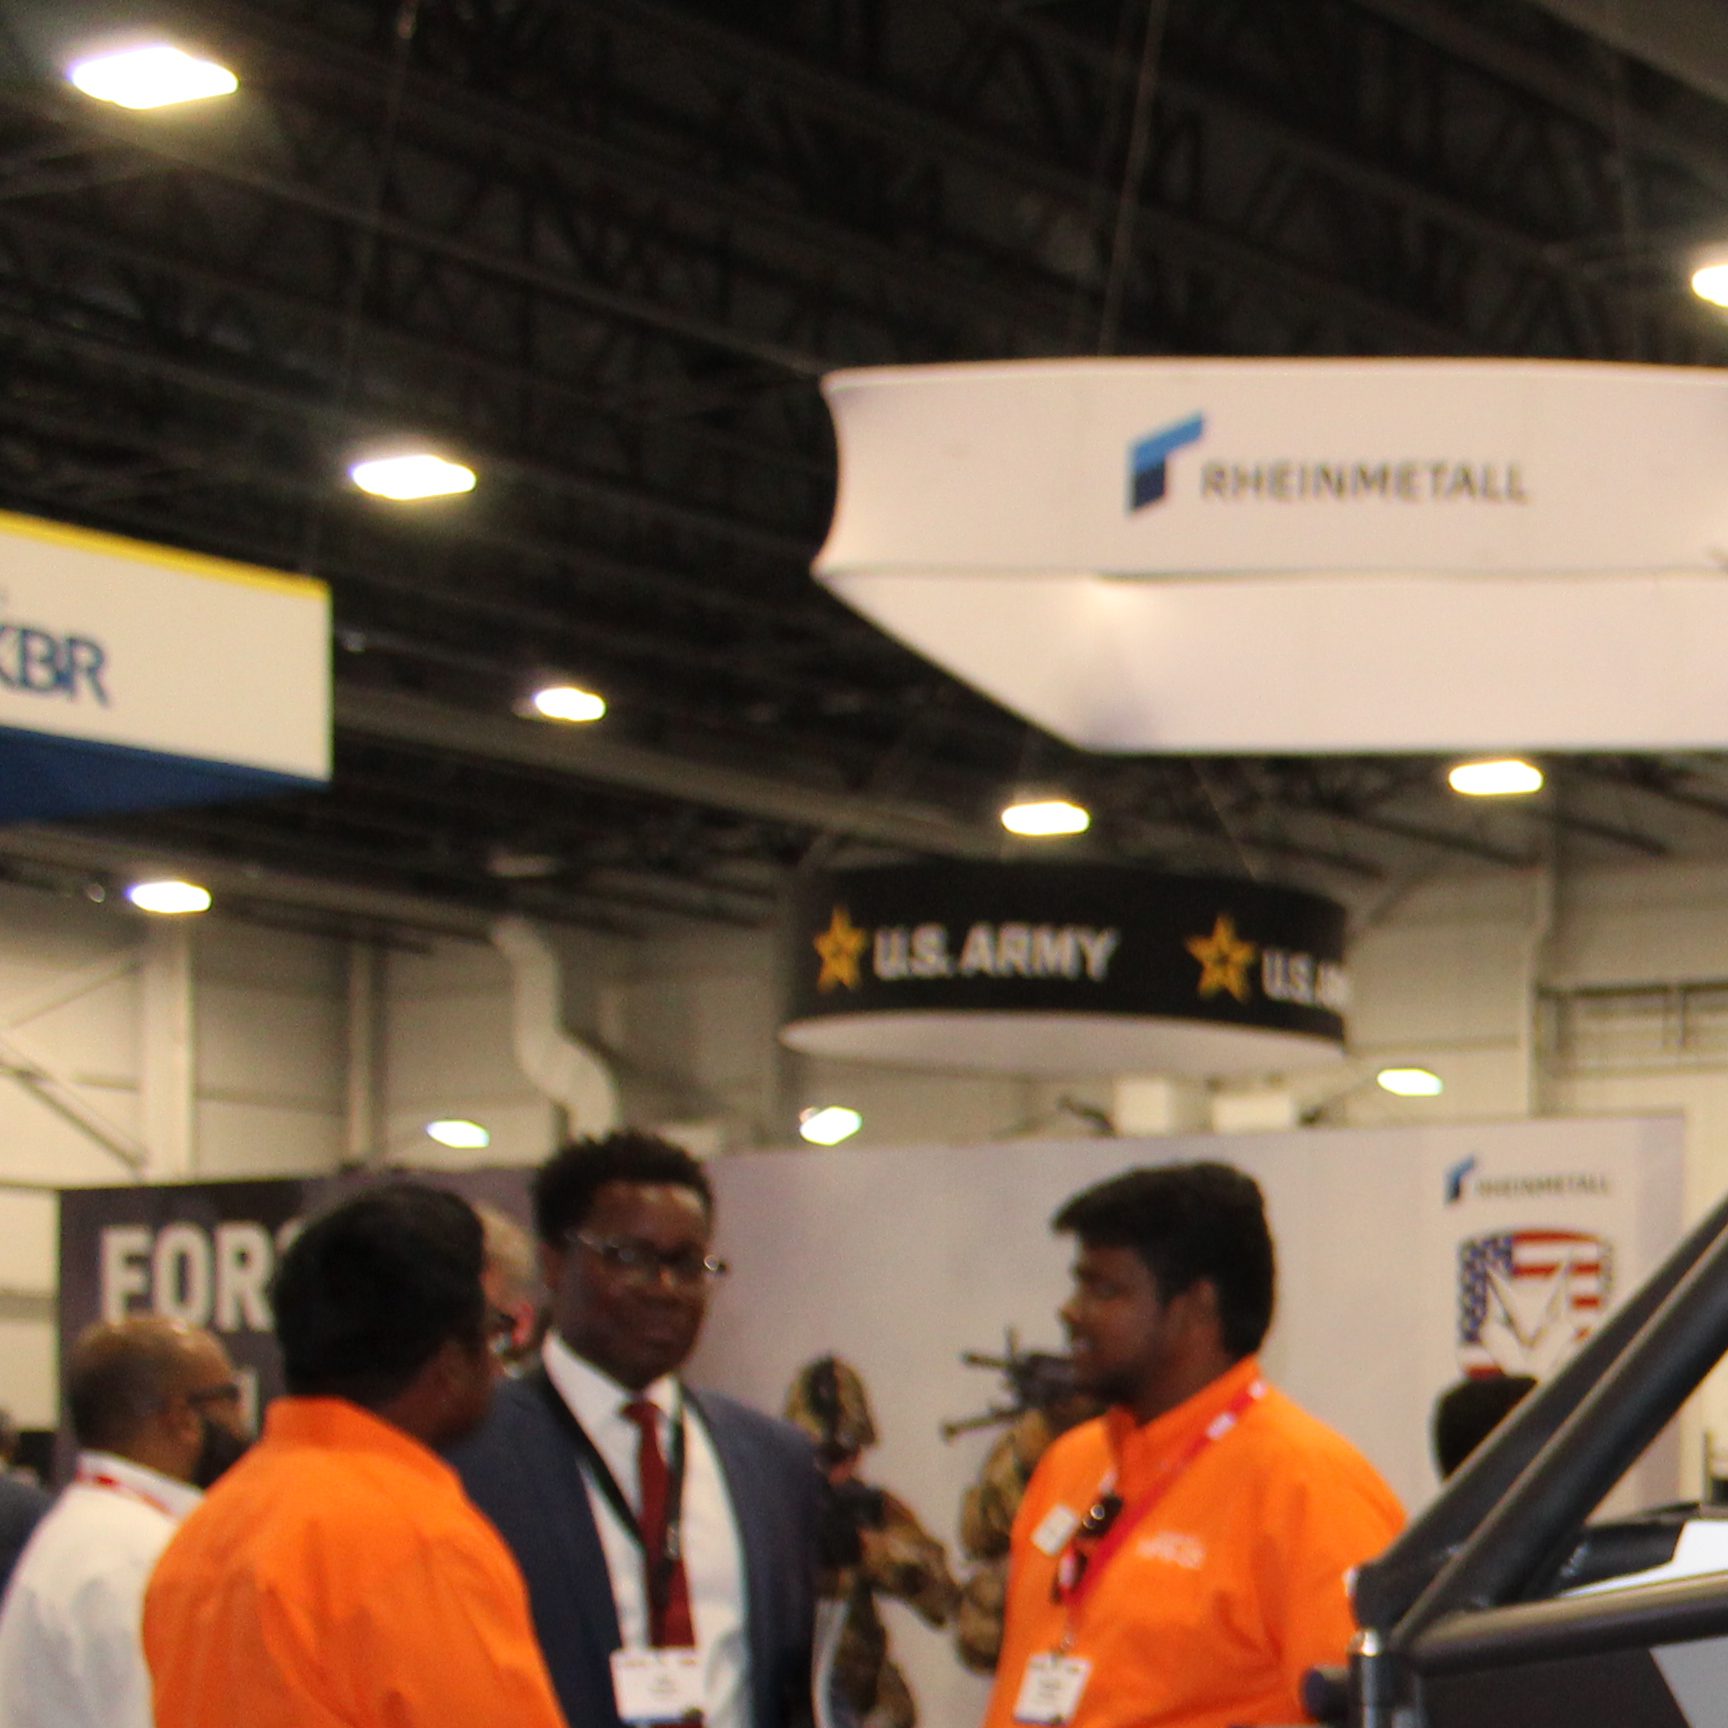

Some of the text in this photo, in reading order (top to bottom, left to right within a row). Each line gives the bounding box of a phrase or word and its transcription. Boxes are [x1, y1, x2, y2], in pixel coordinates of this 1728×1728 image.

[1201, 458, 1527, 503] RHEINMETALL
[957, 921, 1119, 983] ARMY
[101, 1217, 304, 1333] FOR
